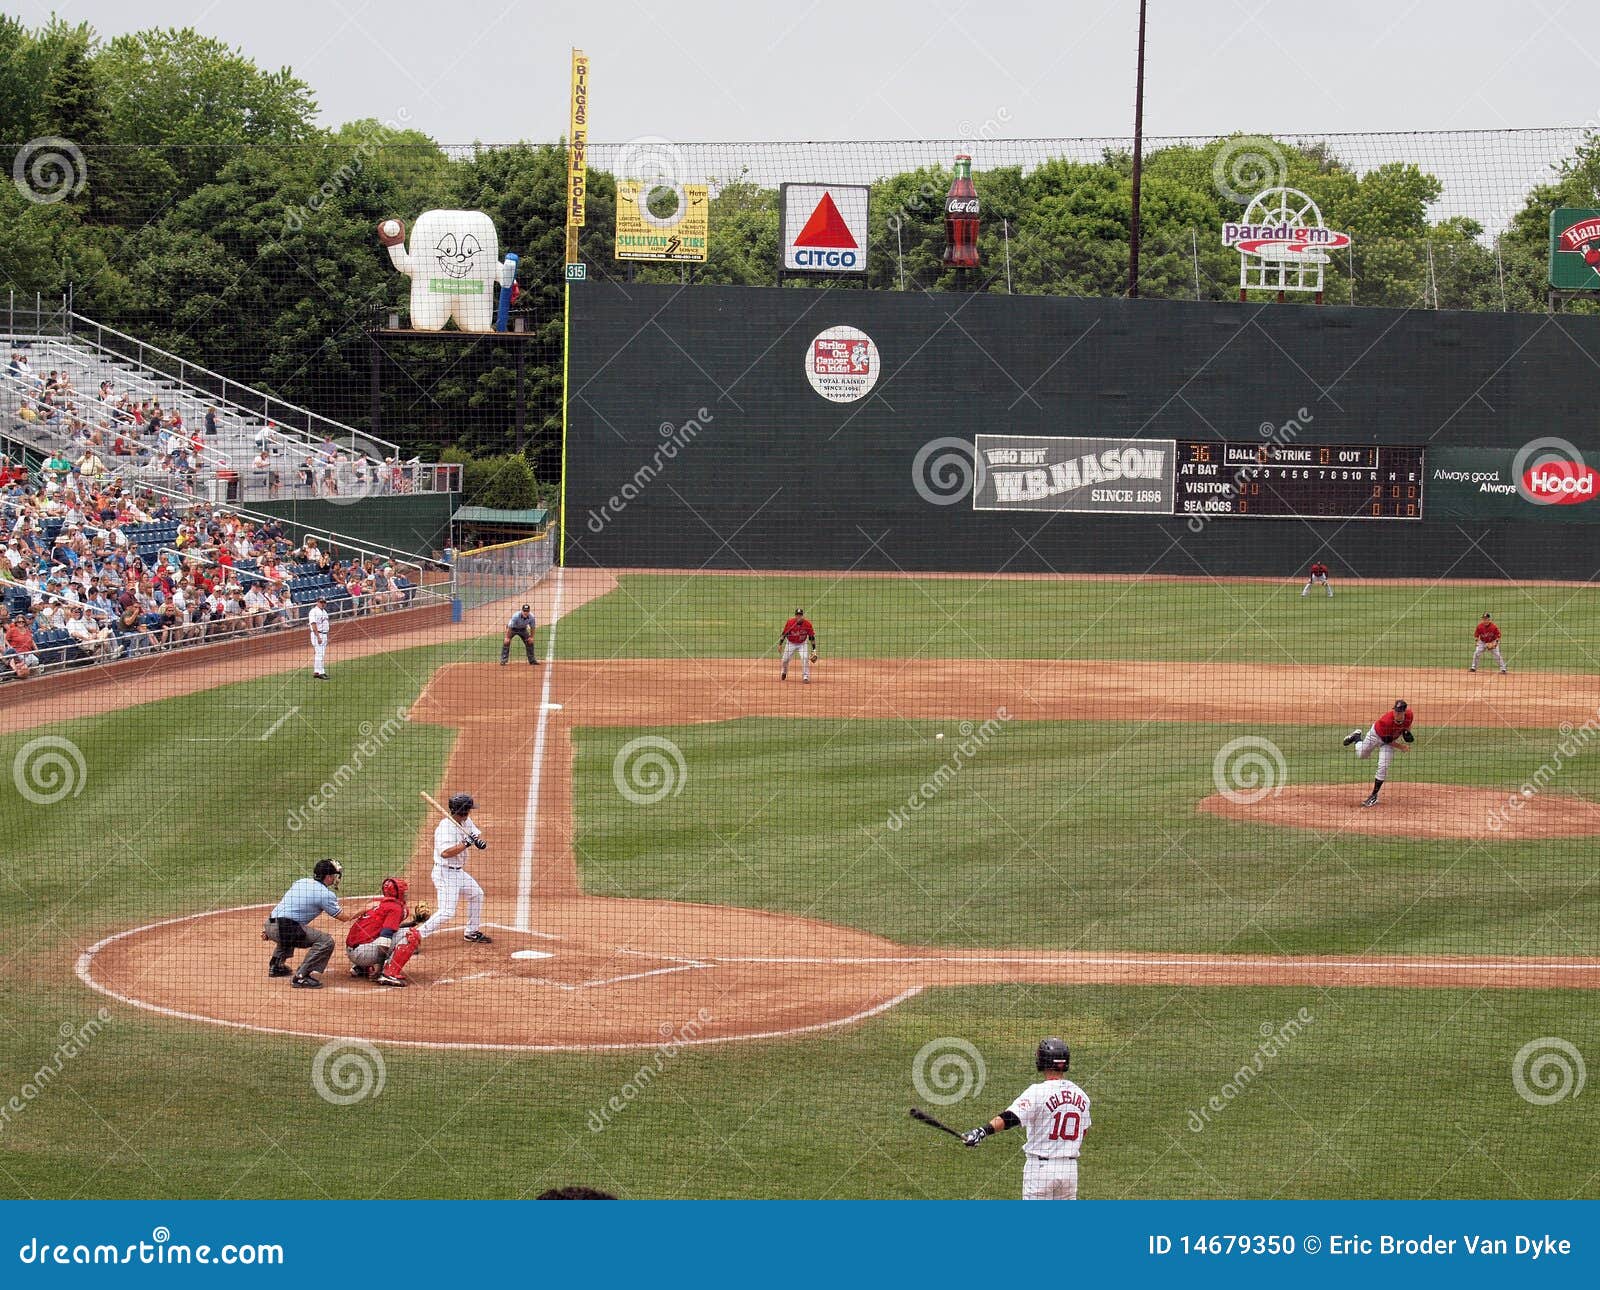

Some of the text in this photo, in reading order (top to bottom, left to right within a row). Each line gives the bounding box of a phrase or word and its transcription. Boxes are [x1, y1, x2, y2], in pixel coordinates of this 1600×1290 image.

[572, 65, 587, 217] BINGAS FOWL POLE
[1225, 222, 1329, 244] paradigm
[618, 235, 705, 248] SULLIVAN TIRE
[794, 250, 857, 267] CITGO
[567, 265, 584, 278] 315
[818, 341, 846, 349] Strike
[816, 356, 849, 365] Cancer
[832, 350, 850, 358] Out
[986, 450, 1047, 465] WHO BUT
[1189, 444, 1210, 462] 36
[1228, 449, 1256, 460] BALL
[1274, 450, 1312, 461] STRIKE
[1320, 447, 1330, 465] 0
[1338, 452, 1361, 462] OUT
[1181, 464, 1219, 475] AT BAT
[1264, 470, 1270, 478] 3
[1280, 470, 1286, 479] 4
[1291, 471, 1298, 479] 5
[1303, 471, 1309, 479] 6
[1319, 471, 1325, 479] 7
[1331, 471, 1337, 480] 8
[1342, 472, 1348, 480] 9
[1351, 472, 1362, 480] 10
[1370, 472, 1377, 481] R
[1408, 473, 1415, 481] E
[1433, 470, 1470, 482] Always
[1185, 482, 1231, 494] VISITOR
[1531, 471, 1593, 494] Hood
[1091, 489, 1133, 502] SINCE
[1136, 490, 1162, 503] 1898
[1479, 483, 1517, 496] Always
[1184, 500, 1203, 512] SEA
[1204, 501, 1232, 513] DOGS
[1045, 1090, 1087, 1113] IGLESIAS
[1048, 1112, 1081, 1141] 10
